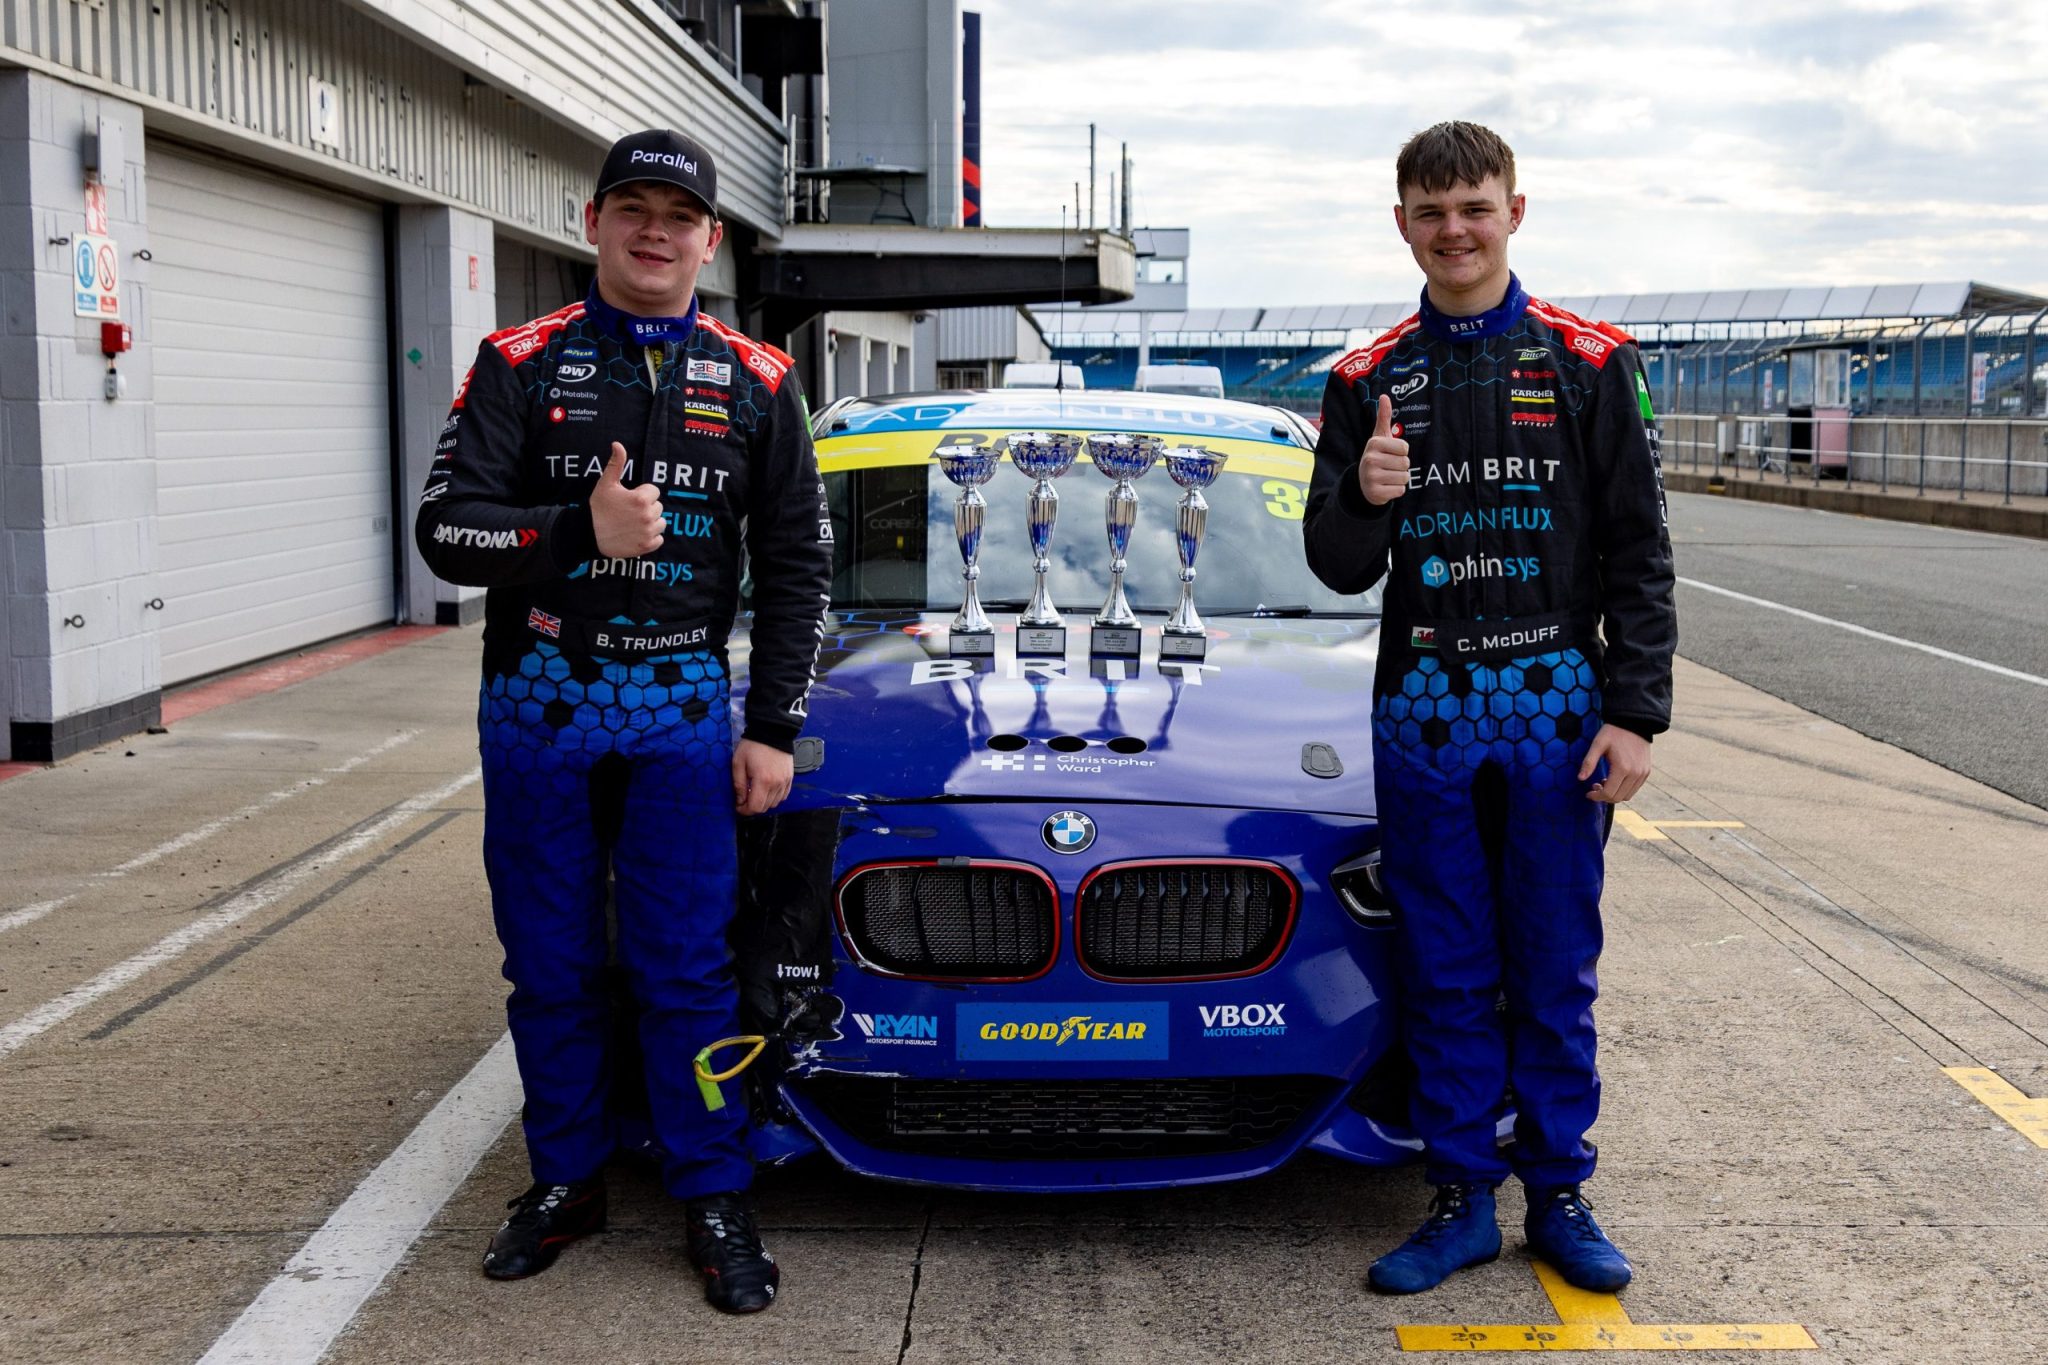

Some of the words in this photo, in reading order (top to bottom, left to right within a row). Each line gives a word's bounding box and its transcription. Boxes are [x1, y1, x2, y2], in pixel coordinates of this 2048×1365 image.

[630, 150, 698, 177] Parallel
[635, 323, 671, 334] BRIT
[1450, 319, 1484, 333] BRIT
[1574, 336, 1605, 355] OMP
[558, 364, 587, 378] DW
[748, 354, 779, 380] OMP
[562, 390, 599, 400] Motability
[697, 387, 730, 400] TEXACO
[568, 408, 598, 416] vodafone
[684, 400, 729, 416] KÄRCHER
[1512, 420, 1555, 428] BATTERY
[684, 427, 727, 440] BATTERY
[652, 460, 730, 492] BRIT
[1408, 460, 1471, 490] EAM
[1483, 456, 1561, 482] BRIT
[1262, 479, 1310, 520] 3
[433, 523, 519, 549] DAYTONA
[1450, 552, 1541, 586] phinsys
[596, 633, 615, 648] B.
[622, 626, 708, 650] TRUNDLEY
[1457, 638, 1477, 652] C.
[1482, 625, 1560, 650] McDUFF
[910, 658, 1222, 686] BRIT
[1056, 755, 1156, 767] Christopher
[1056, 764, 1101, 773] Ward
[1050, 811, 1091, 826] BMW
[785, 966, 812, 978] TOW
[1198, 1003, 1286, 1027] VBOX
[874, 1014, 938, 1038] RYAN
[1203, 1026, 1287, 1038] MOTORSPORT
[866, 1037, 904, 1045] MOTORSPORT
